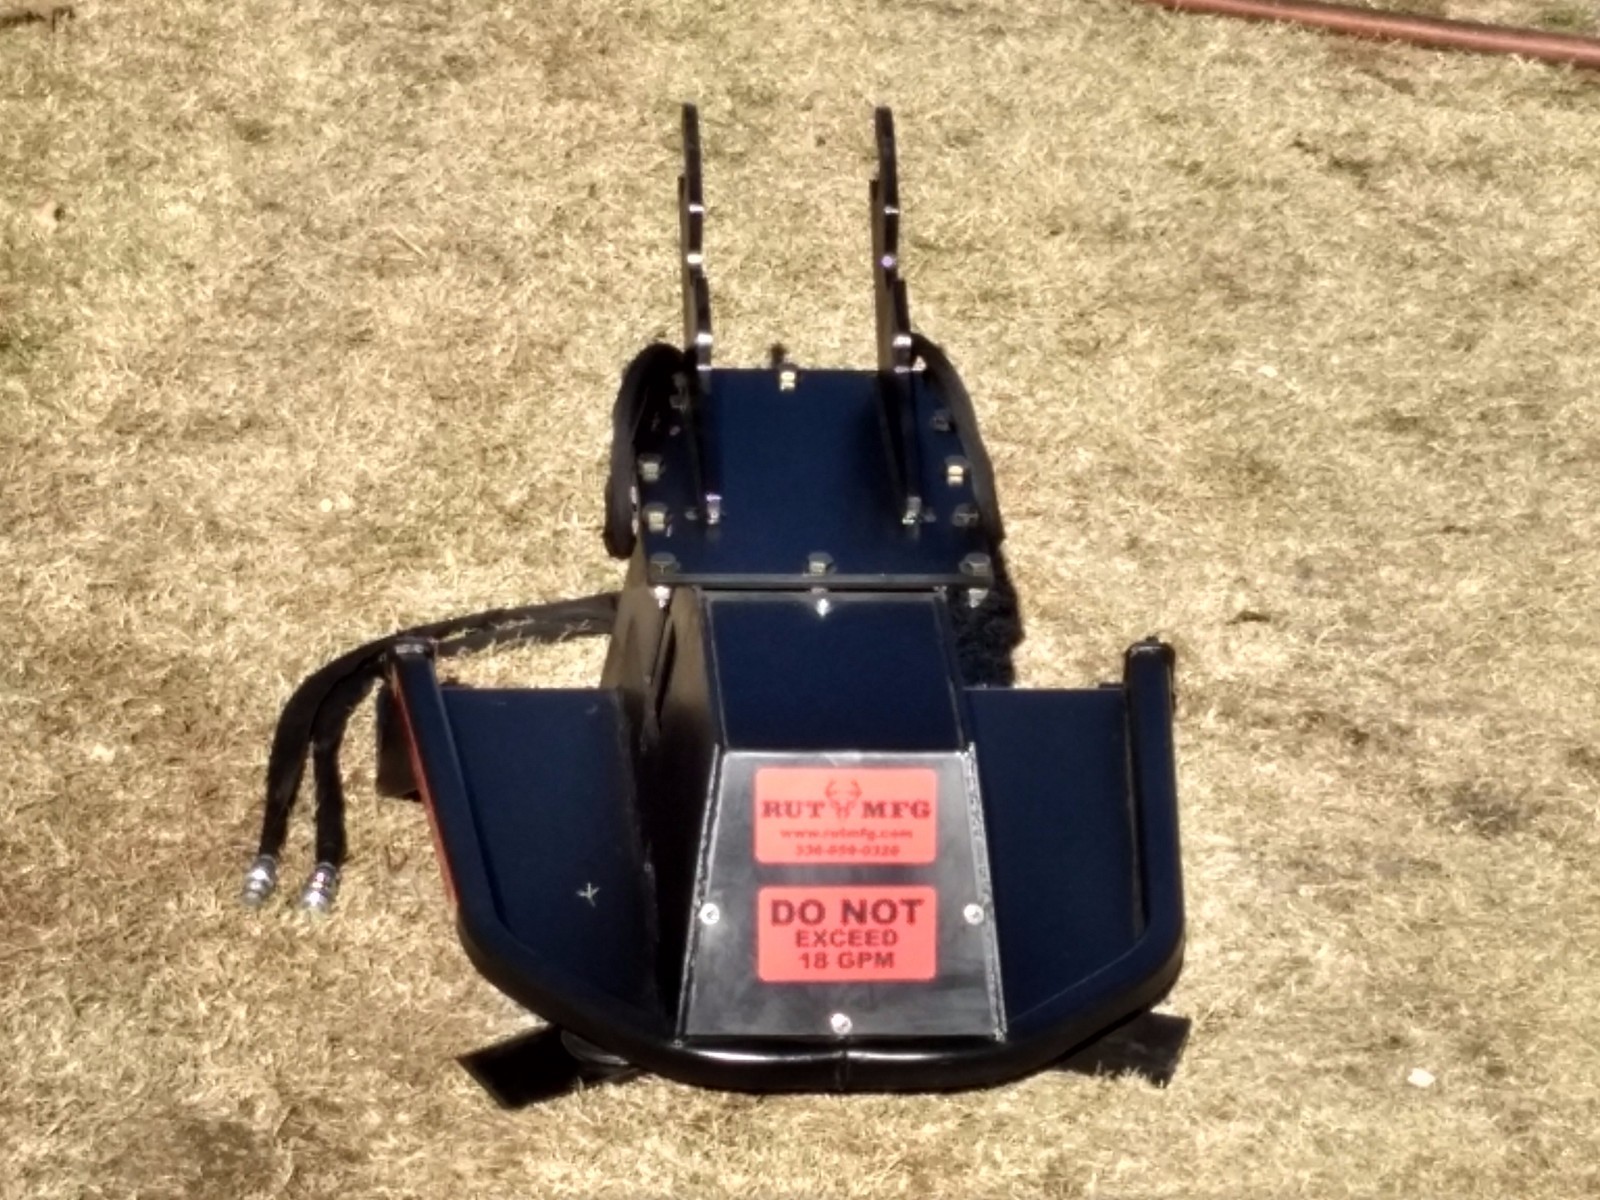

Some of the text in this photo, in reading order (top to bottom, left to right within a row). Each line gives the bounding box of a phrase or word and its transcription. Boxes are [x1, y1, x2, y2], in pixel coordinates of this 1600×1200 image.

[761, 799, 931, 819] RUT MFG
[771, 898, 924, 927] DO NOT
[795, 928, 898, 948] EXCEED
[799, 951, 895, 970] 18 GPM
